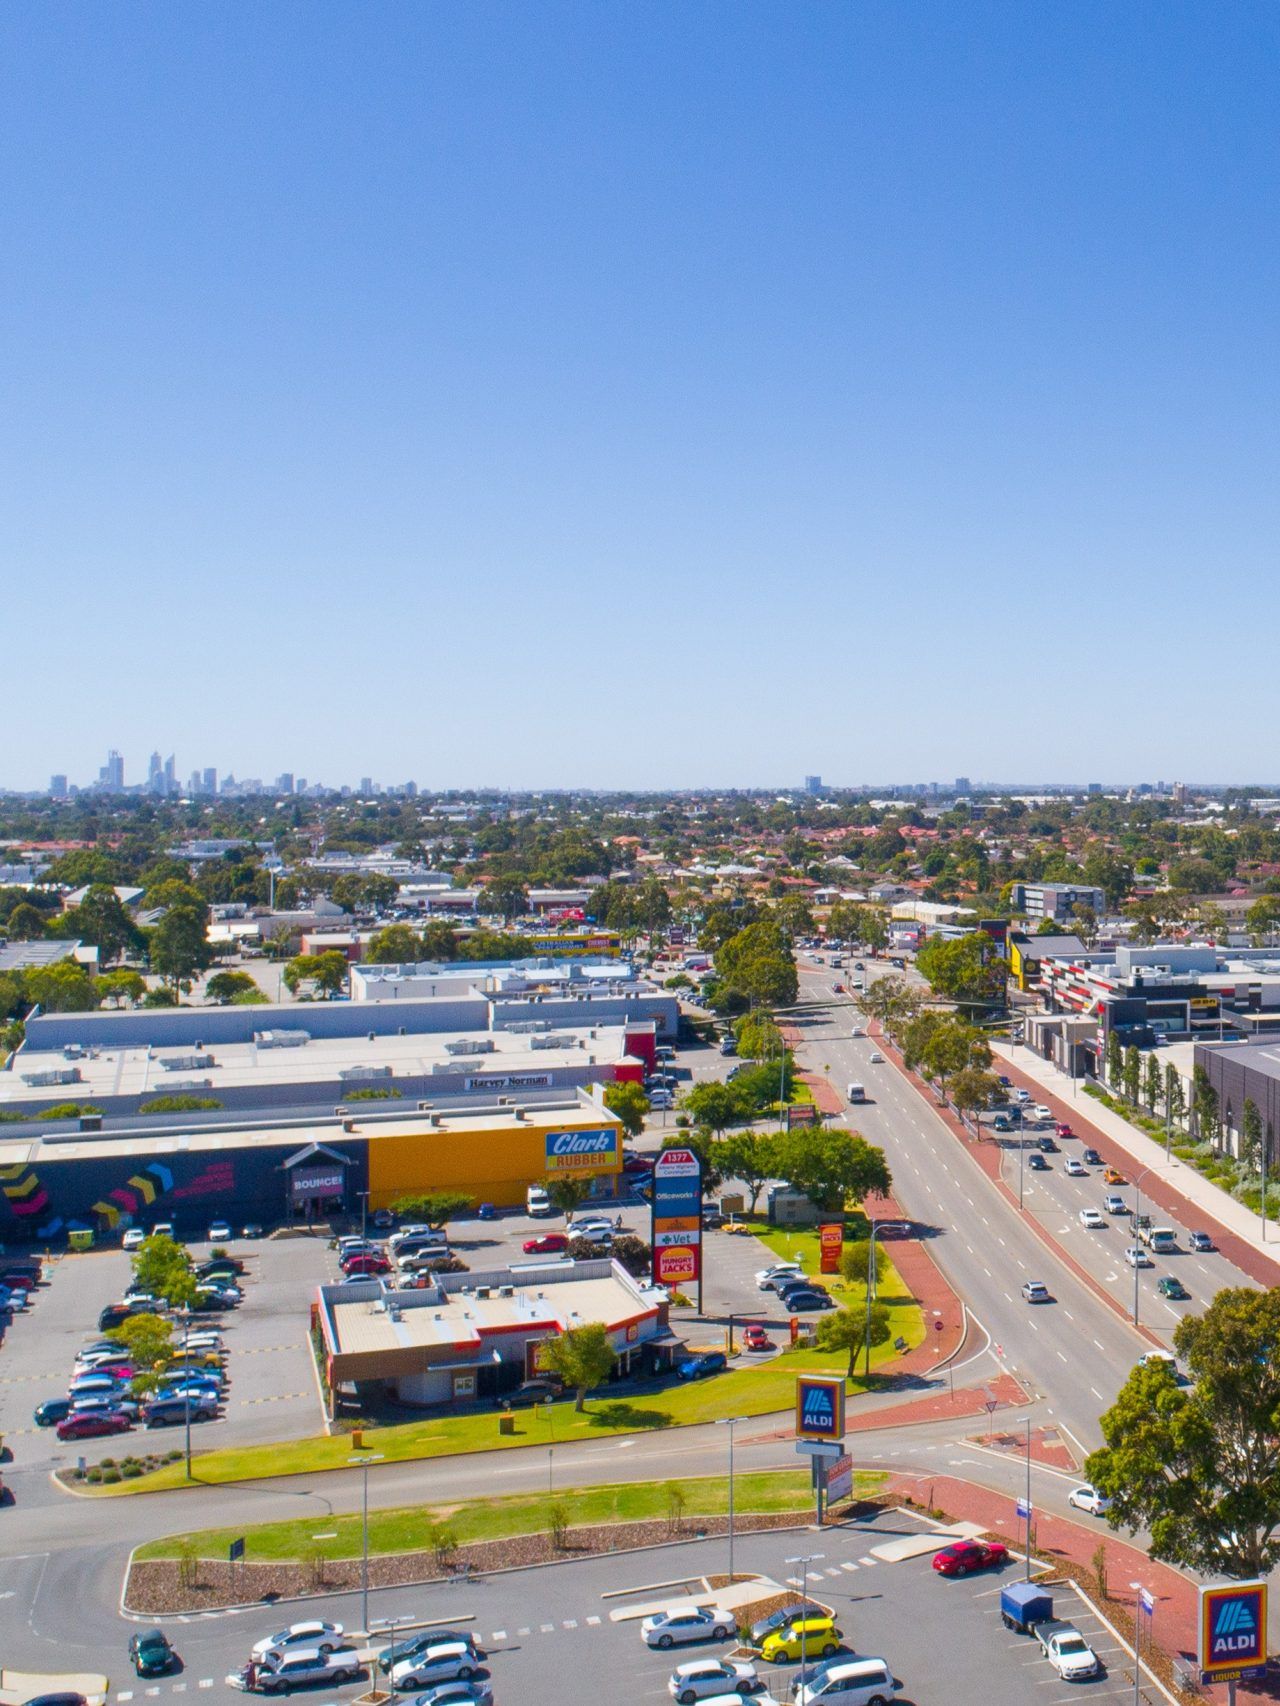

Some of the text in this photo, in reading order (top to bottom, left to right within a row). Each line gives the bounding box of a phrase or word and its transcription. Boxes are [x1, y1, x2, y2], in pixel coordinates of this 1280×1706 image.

[470, 1076, 548, 1088] Harvey Norman
[553, 1131, 610, 1154] Clark
[556, 1152, 606, 1167] RUBBER
[667, 1153, 688, 1162] 1377
[673, 1234, 691, 1244] Vet
[662, 1256, 692, 1265] HUNGRY
[804, 1414, 833, 1427] ALDI
[1214, 1634, 1256, 1653] ALDI
[1211, 1671, 1241, 1682] LIQUOR
